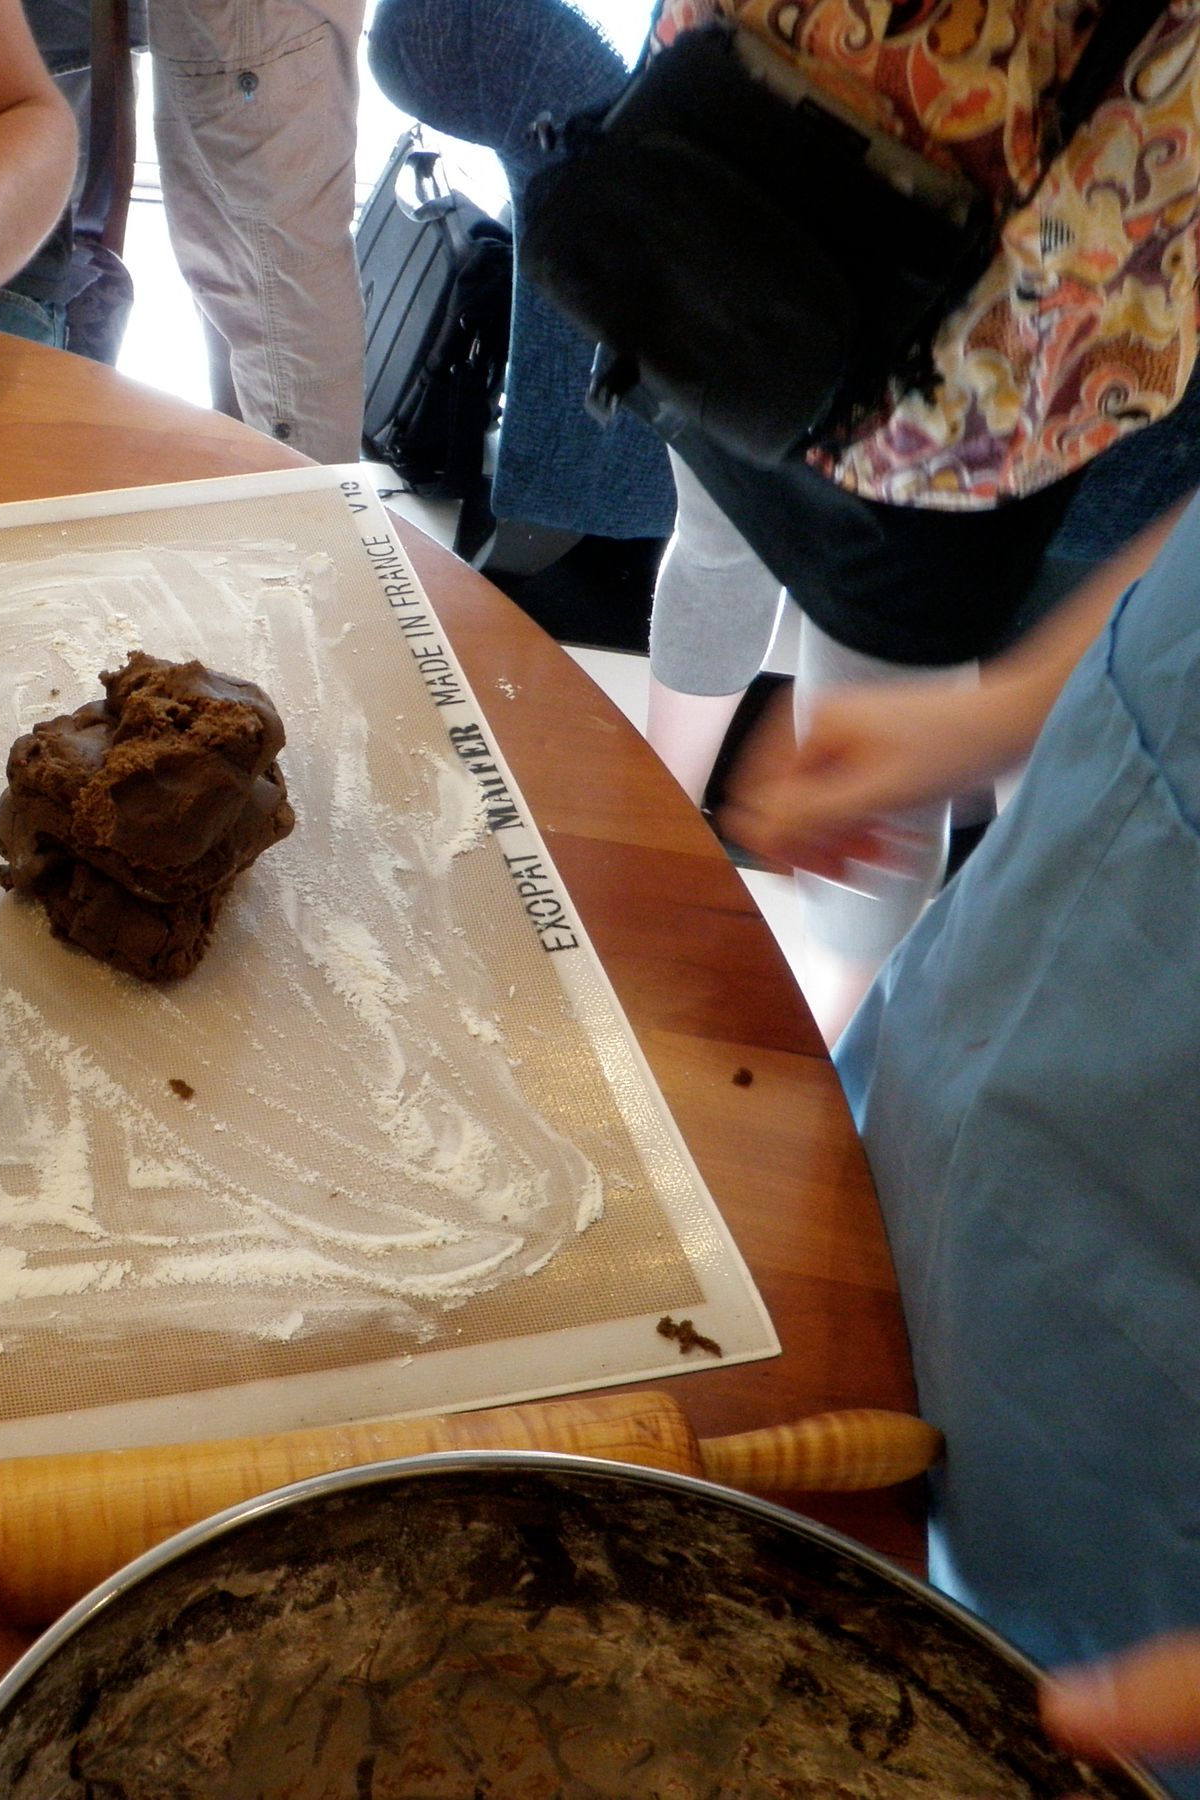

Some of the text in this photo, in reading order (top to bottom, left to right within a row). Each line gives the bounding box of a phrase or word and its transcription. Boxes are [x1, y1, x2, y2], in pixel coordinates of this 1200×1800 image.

[340, 481, 362, 498] 10
[348, 503, 368, 514] V
[361, 534, 420, 609] FRANCE
[405, 615, 435, 638] IN
[411, 644, 466, 707] MADE
[503, 853, 579, 953] EXOPAT
